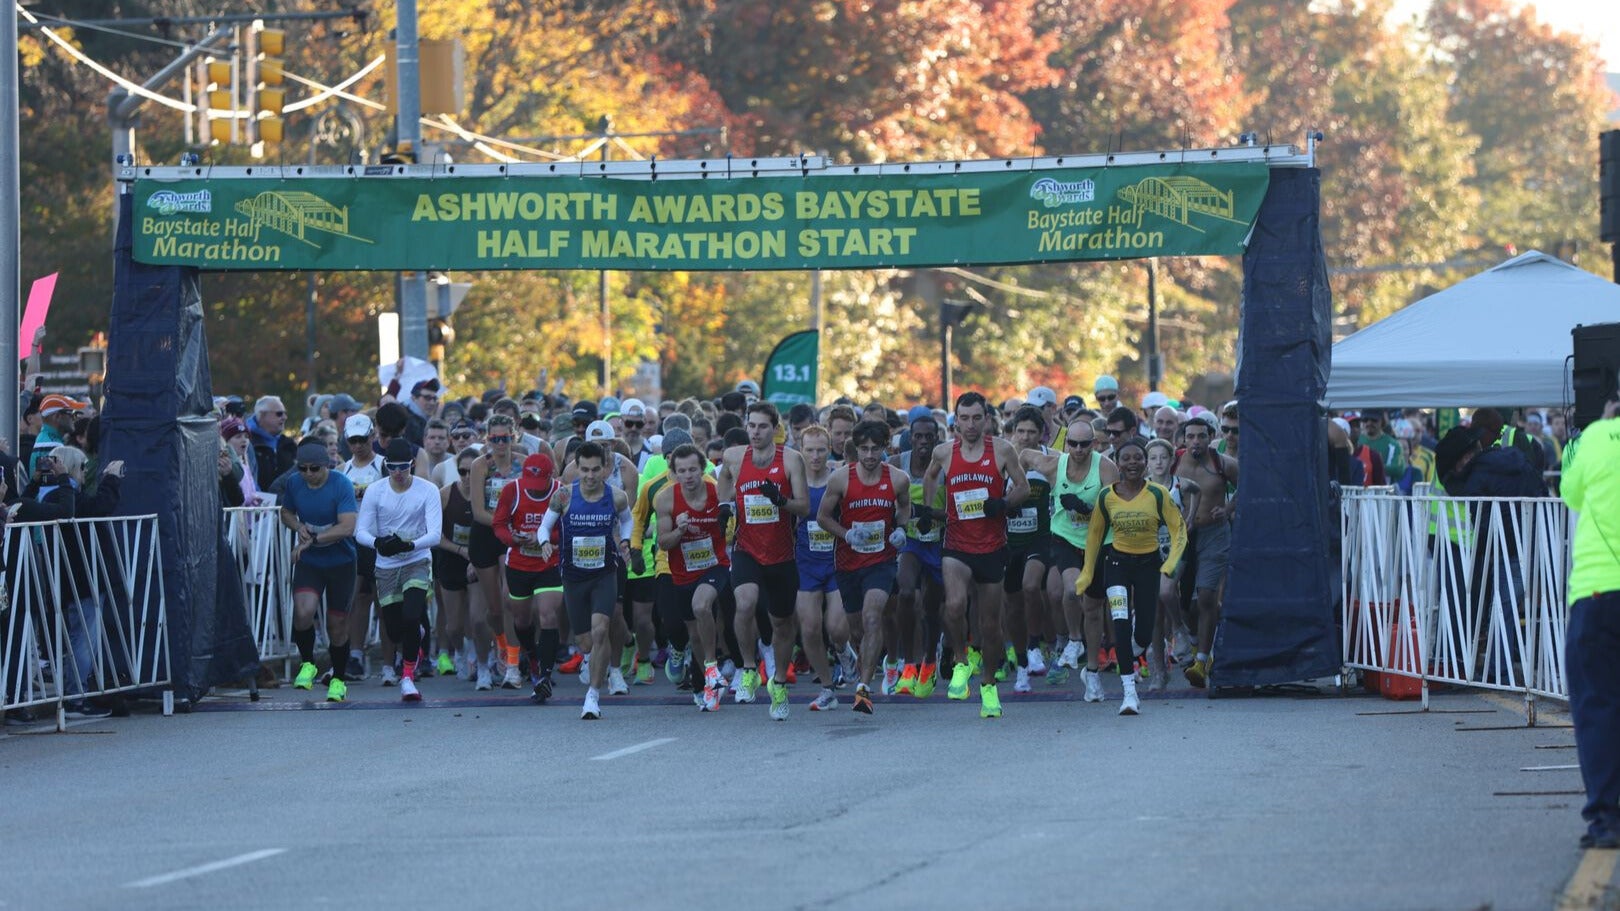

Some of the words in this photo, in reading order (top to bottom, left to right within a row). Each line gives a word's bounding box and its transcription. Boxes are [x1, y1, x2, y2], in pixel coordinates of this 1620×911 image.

[411, 192, 617, 221] ASHWORTH
[628, 192, 784, 223] AWARDS
[796, 188, 981, 219] BAYSTATE
[1027, 207, 1103, 233] Baystate
[1108, 204, 1145, 229] Half
[142, 217, 219, 239] Baystate
[225, 218, 264, 242] Half
[477, 230, 570, 258] HALF
[581, 230, 785, 260] MARATHON
[798, 227, 916, 257] START
[1038, 226, 1164, 252] Marathon
[152, 237, 280, 261] Marathon
[773, 364, 810, 382] 13.1
[950, 473, 993, 485] WHIRLAWAY
[848, 498, 893, 509] WHIRLAWAY
[964, 502, 983, 513] 4118
[569, 513, 612, 521] CAMBRIDGE
[750, 507, 773, 517] 3650
[1012, 519, 1032, 528] 5043
[579, 549, 600, 558] 3906
[689, 550, 711, 560] 4027
[1111, 598, 1123, 607] 46
